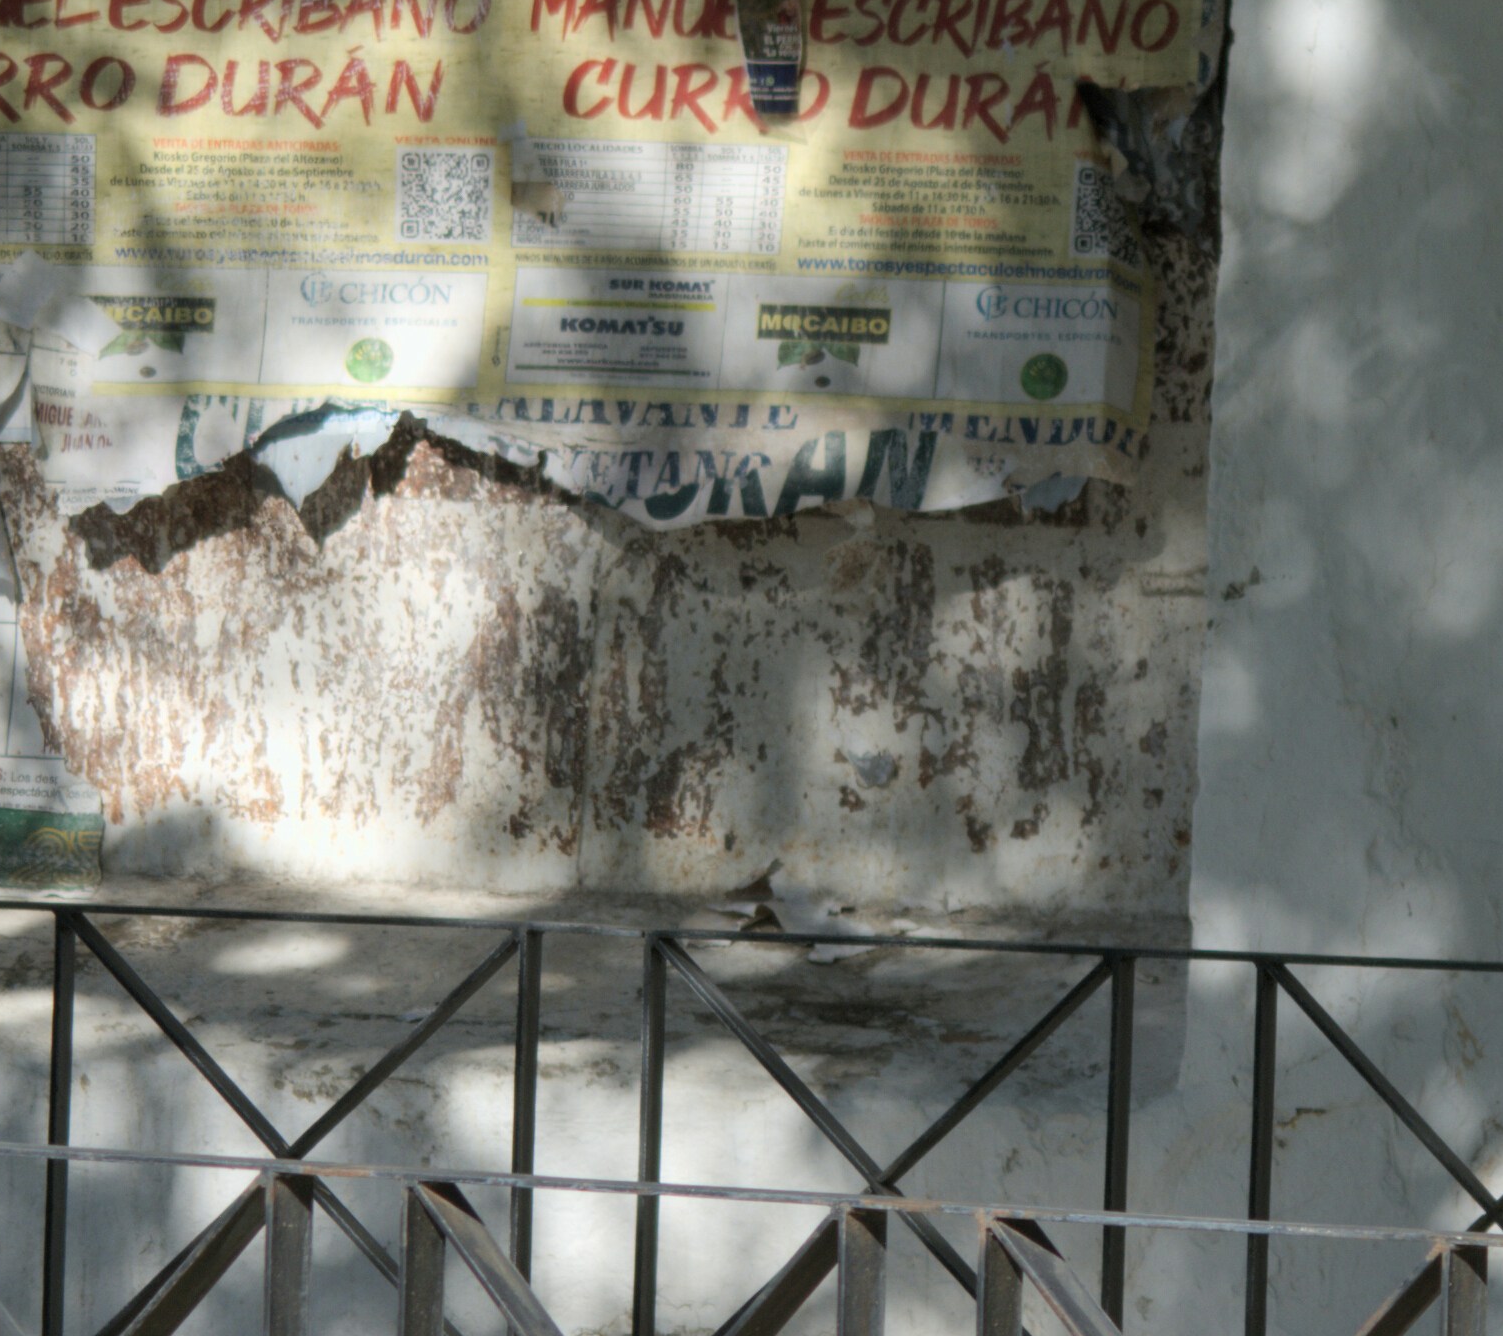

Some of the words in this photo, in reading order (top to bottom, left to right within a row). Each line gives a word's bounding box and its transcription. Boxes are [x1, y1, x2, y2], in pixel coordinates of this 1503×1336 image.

[156, 43, 444, 128] DURÁN
[338, 276, 452, 306] CHICÓN
[560, 315, 684, 337] KOMATSU
